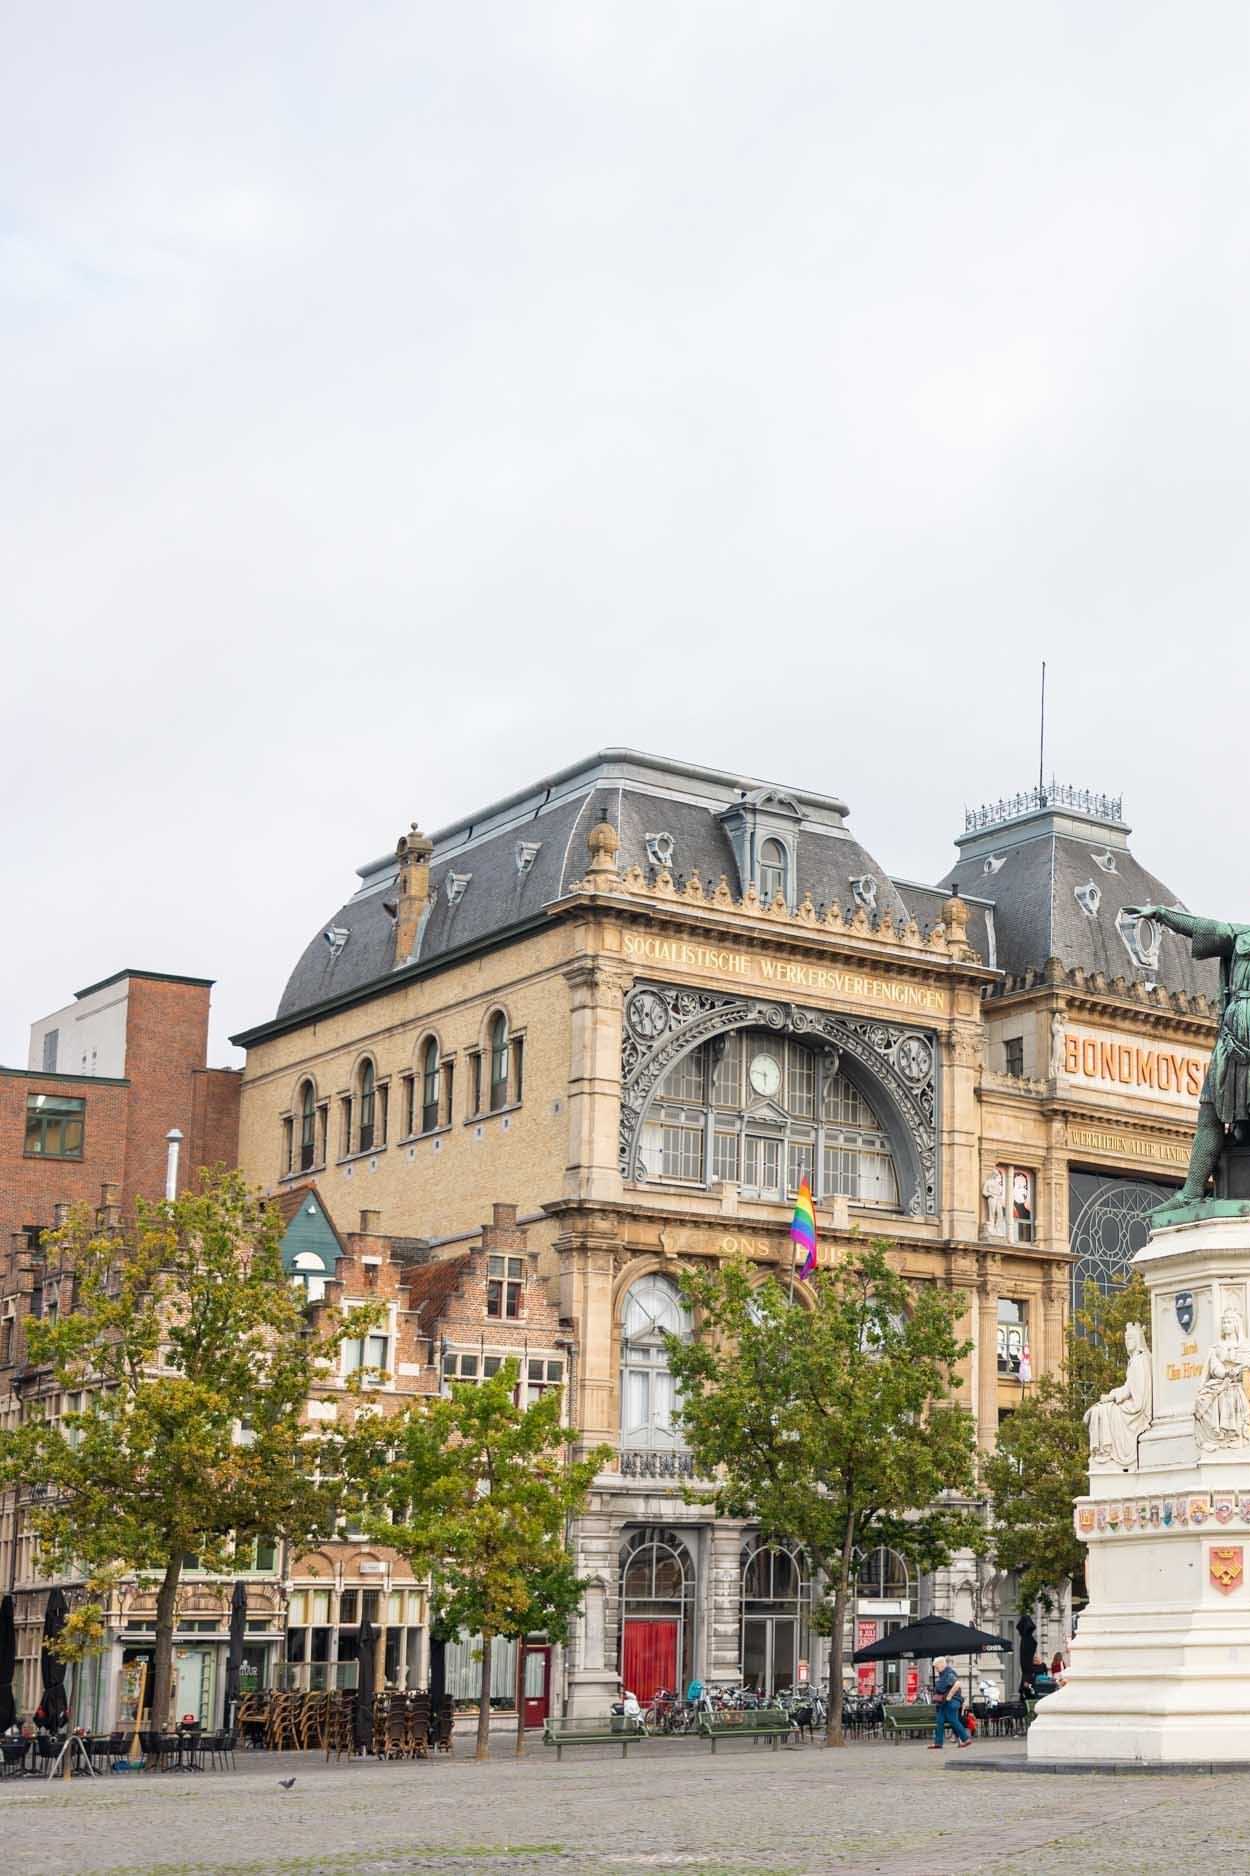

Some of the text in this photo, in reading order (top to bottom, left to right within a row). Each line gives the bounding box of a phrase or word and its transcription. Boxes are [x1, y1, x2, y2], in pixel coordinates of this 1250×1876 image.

[623, 935, 945, 1011] SOCIALISTISCHE WERKERSVEREENIGINGEN
[722, 1236, 769, 1256] ONS
